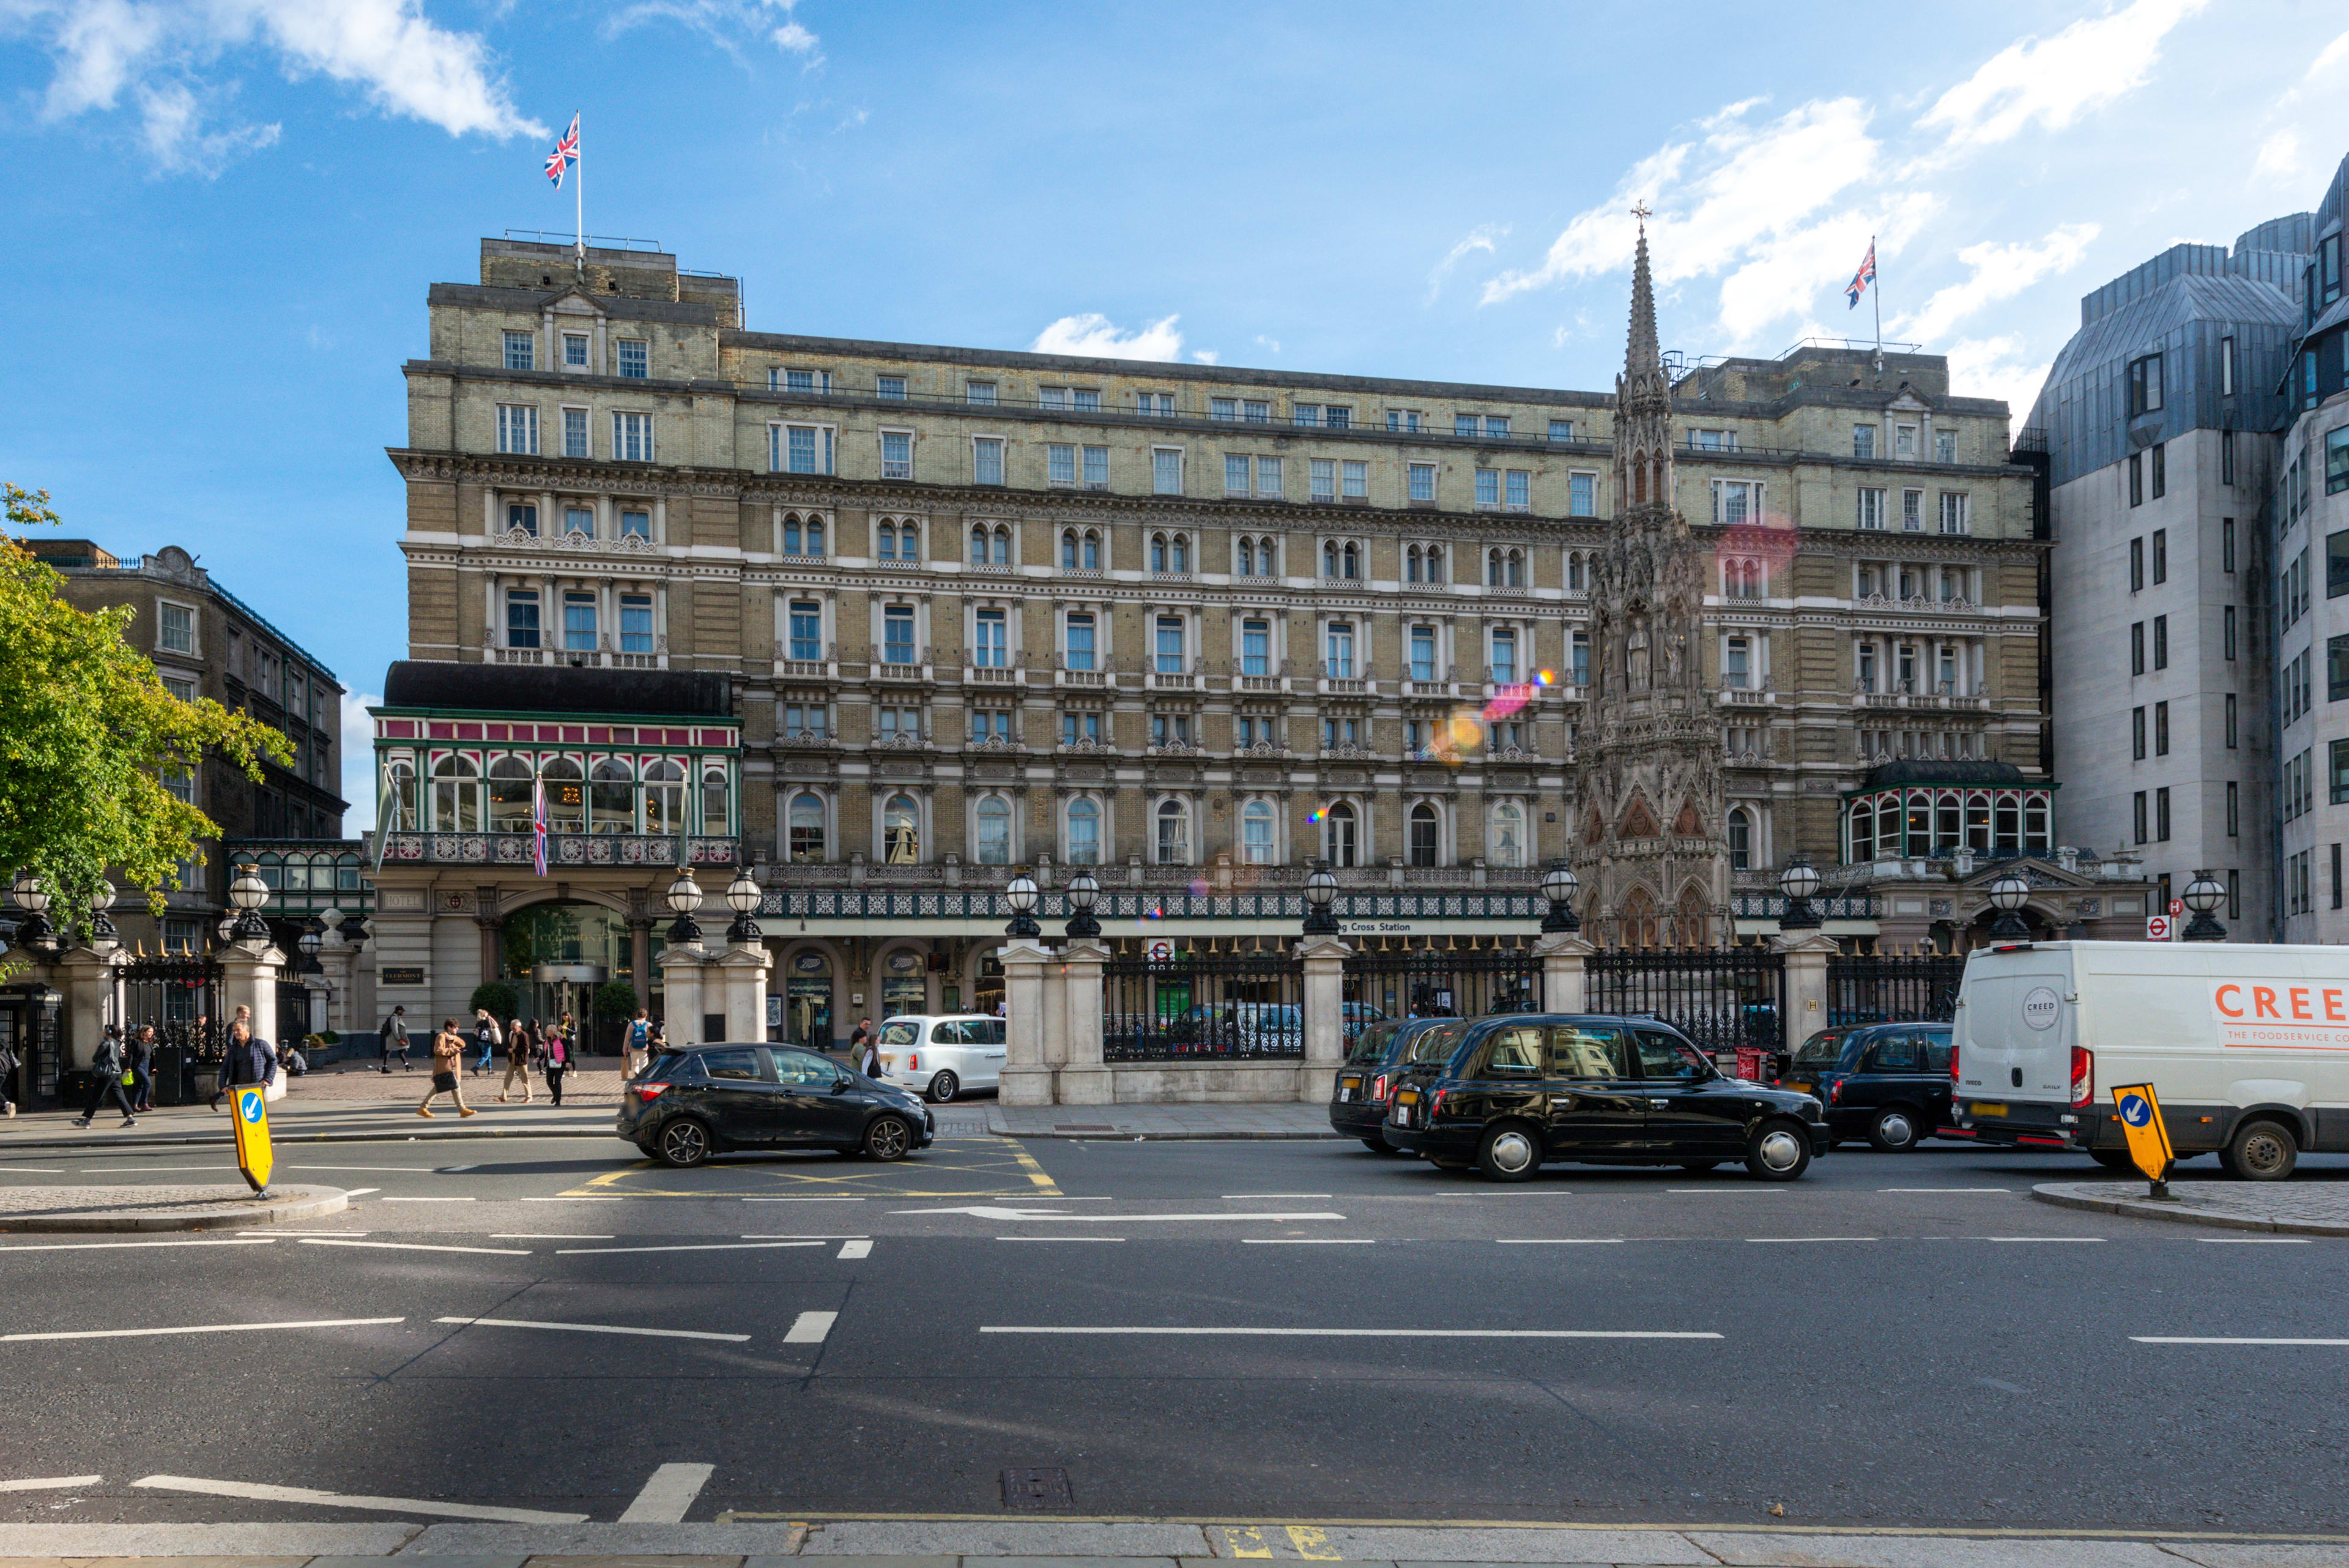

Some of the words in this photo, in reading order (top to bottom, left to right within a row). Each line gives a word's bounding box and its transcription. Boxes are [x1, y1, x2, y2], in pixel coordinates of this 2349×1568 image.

[386, 896, 420, 905] HOTEL
[2170, 902, 2179, 913] H
[2215, 984, 2347, 1021] CREE
[2252, 1031, 2329, 1042] FOODSERVICE
